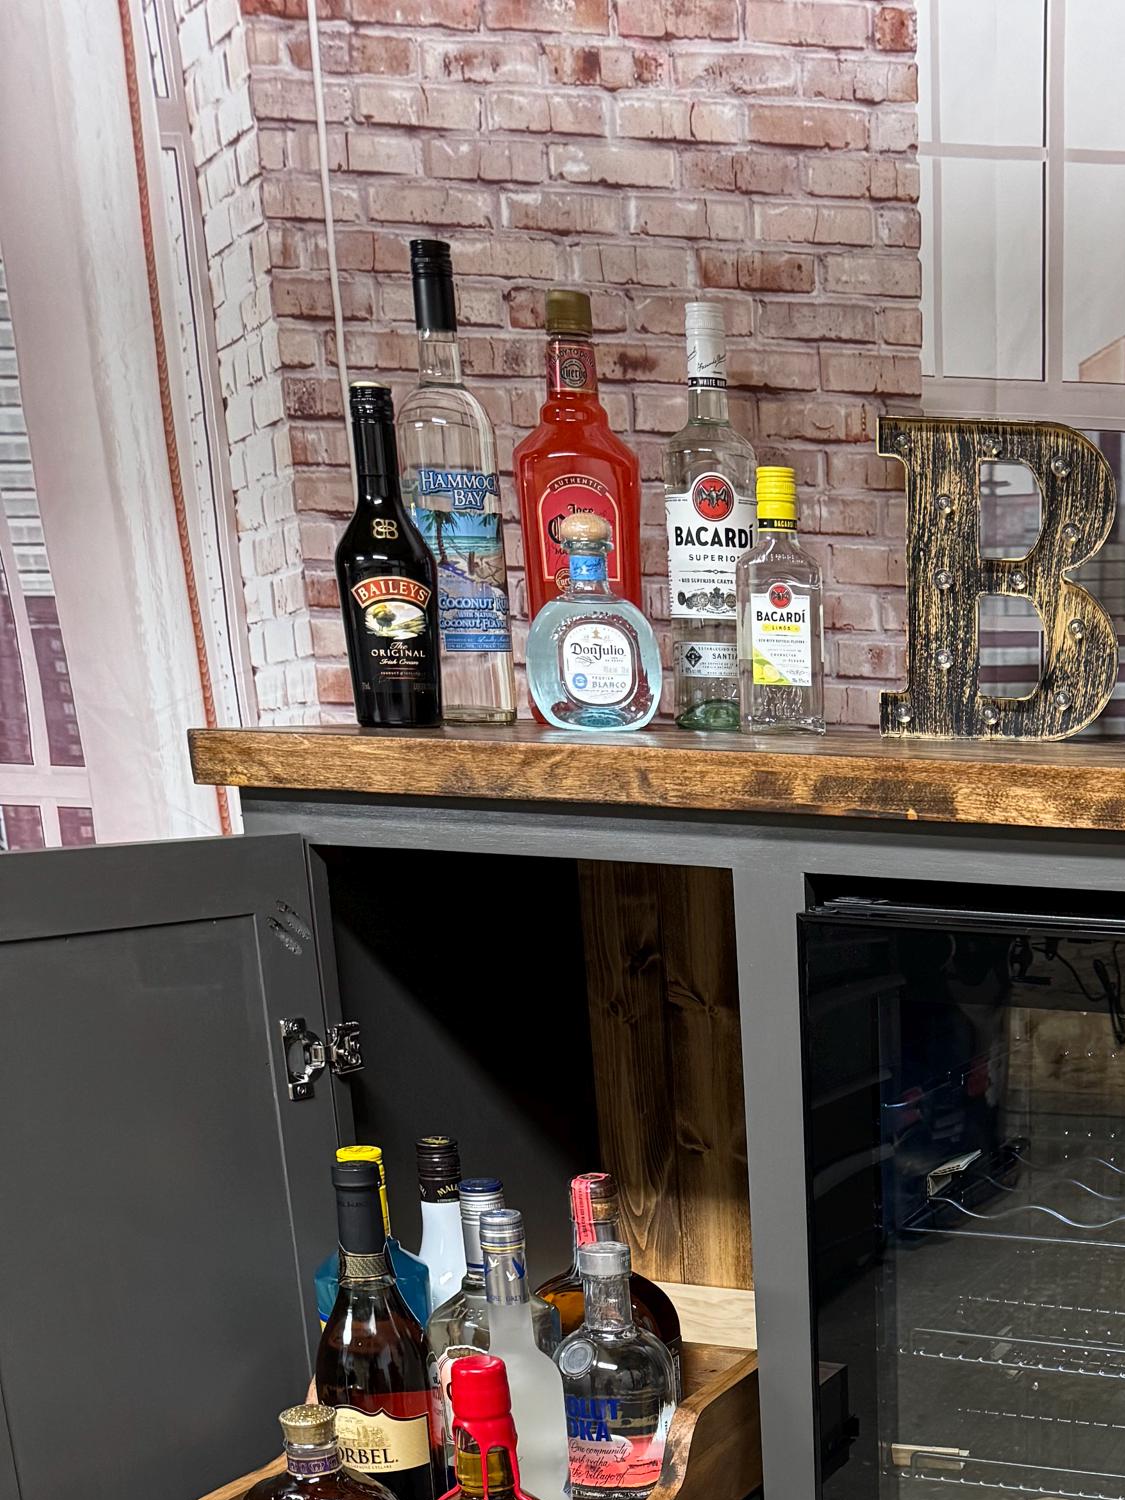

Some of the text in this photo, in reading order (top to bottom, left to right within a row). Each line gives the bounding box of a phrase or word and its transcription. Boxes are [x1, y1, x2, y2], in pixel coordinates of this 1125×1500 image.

[554, 477, 603, 491] AUTHENTIC
[454, 489, 482, 506] BAY
[675, 524, 753, 549] BACARDÍ
[688, 553, 740, 563] SUPERIO
[358, 580, 428, 601] BAILEYS
[439, 597, 493, 610] COCONUT
[756, 609, 806, 623] BACARDÍ
[371, 648, 426, 658] ORIGINAL
[591, 681, 627, 689] BLANCO
[564, 1394, 621, 1420] OLUT
[567, 1420, 613, 1442] DKA
